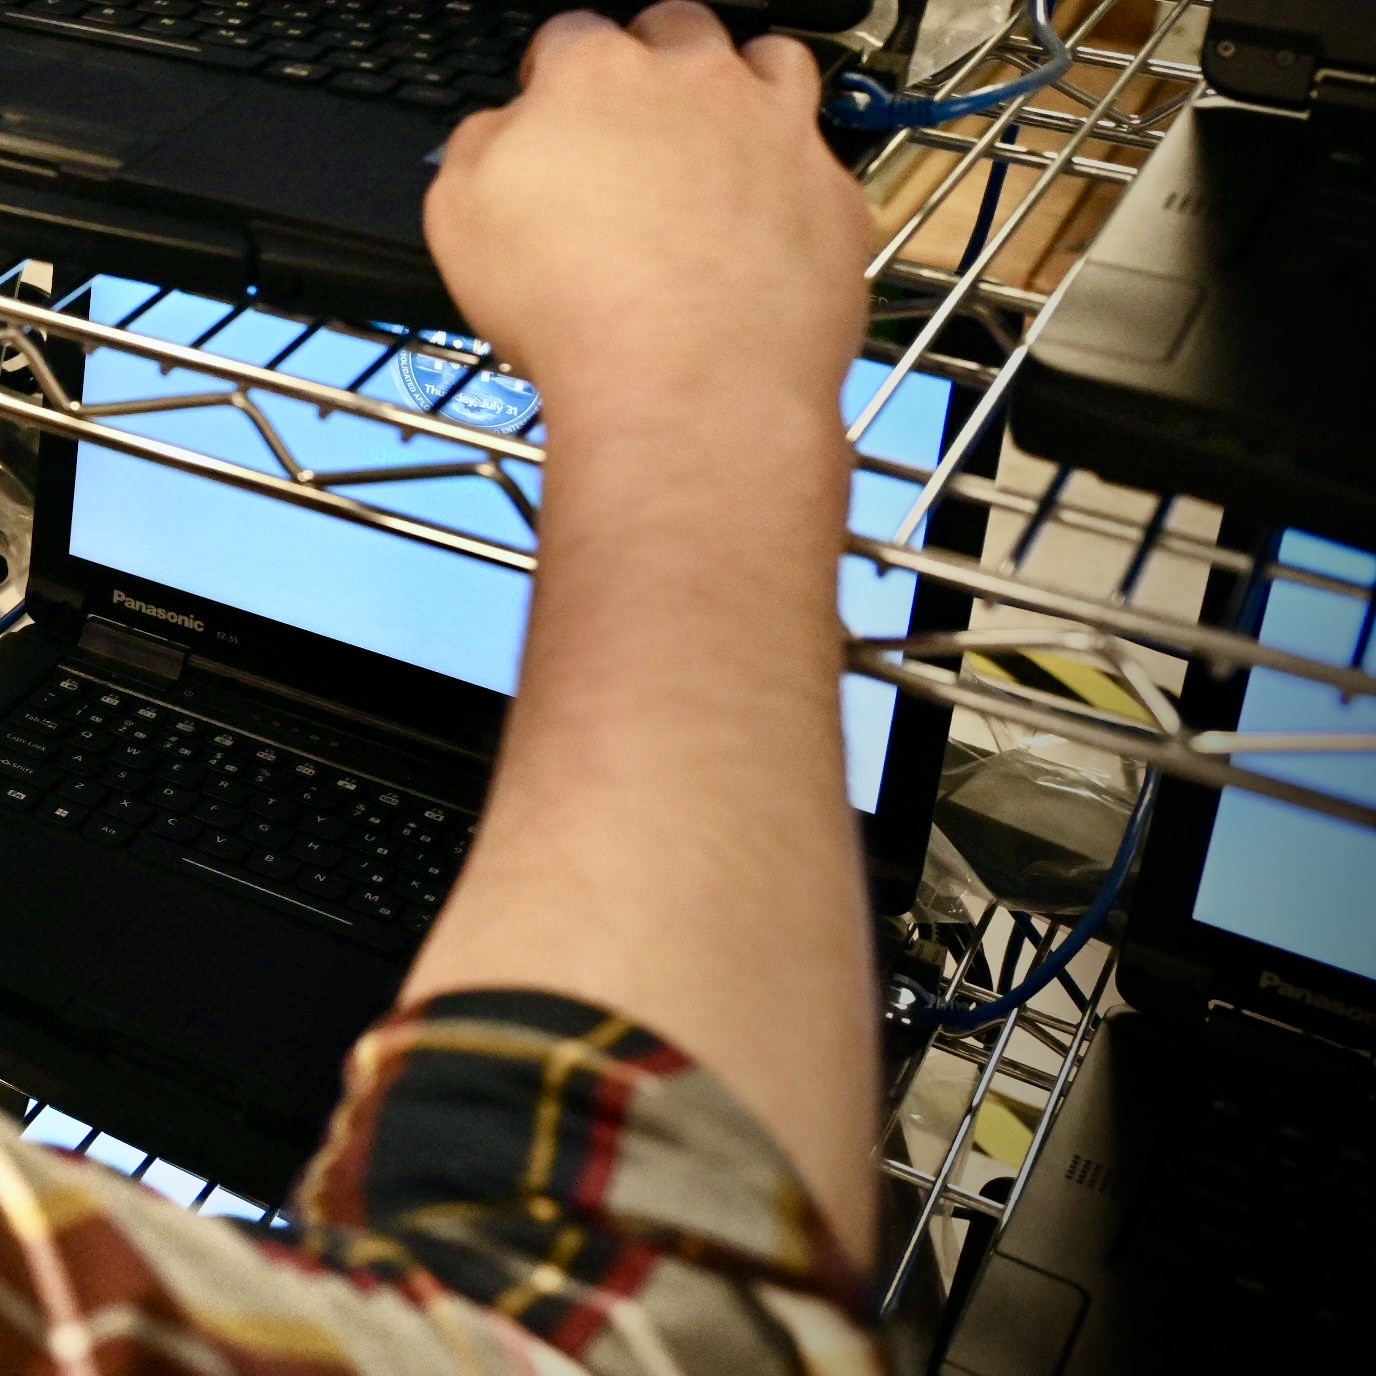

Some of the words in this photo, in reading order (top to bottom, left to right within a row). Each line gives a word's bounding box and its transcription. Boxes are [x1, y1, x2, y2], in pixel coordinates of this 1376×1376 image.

[481, 399, 504, 416] July
[506, 404, 519, 416] 31
[112, 589, 205, 632] Panasonic
